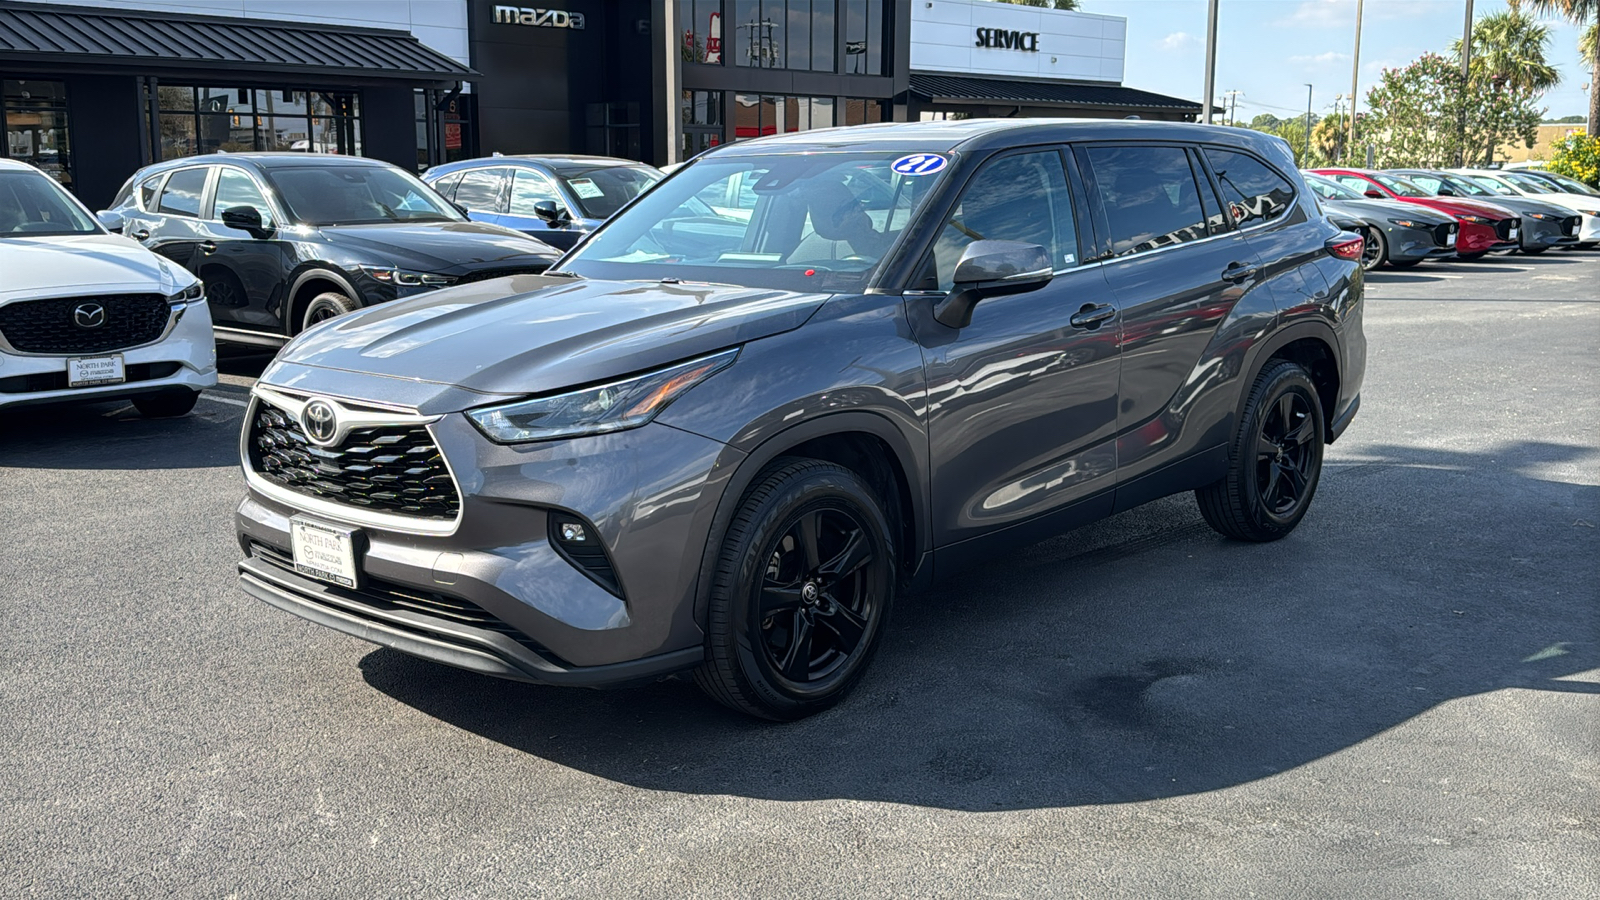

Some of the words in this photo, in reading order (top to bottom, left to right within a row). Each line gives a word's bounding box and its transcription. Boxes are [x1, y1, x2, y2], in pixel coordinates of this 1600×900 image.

[975, 27, 1040, 52] SERVICE
[897, 156, 940, 173] 21
[77, 362, 99, 370] NORTH
[100, 361, 116, 369] PARK
[300, 532, 323, 547] NORTH
[325, 538, 343, 552] PARK
